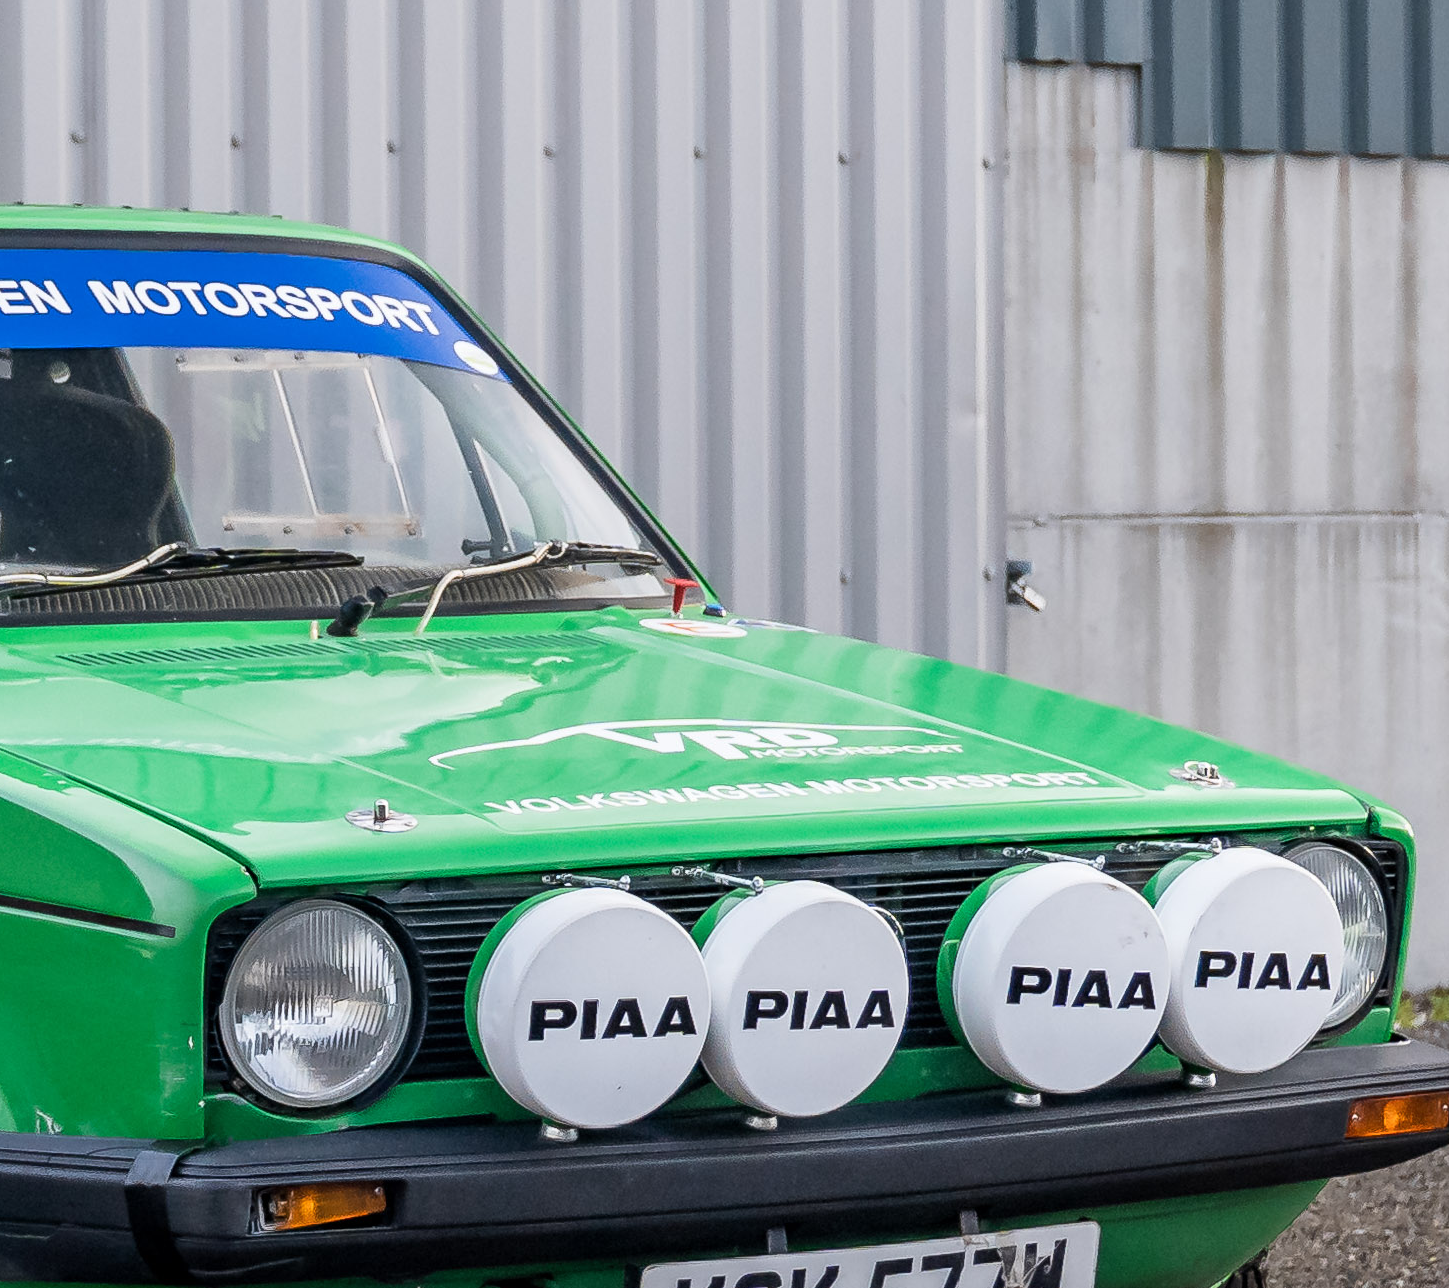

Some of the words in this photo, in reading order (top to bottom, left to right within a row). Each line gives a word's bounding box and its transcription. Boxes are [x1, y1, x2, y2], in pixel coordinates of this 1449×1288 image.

[86, 279, 441, 337] MOTORSPORT
[584, 726, 840, 761] VRD
[748, 743, 965, 760] MOTORSPORT
[483, 781, 809, 816] VOLKSWAGEN
[804, 771, 1100, 796] MOTORSPORT
[1005, 965, 1157, 1011] PIAA
[1194, 950, 1332, 992] PIAA
[527, 995, 698, 1042] PIAA
[742, 989, 896, 1031] PIAA
